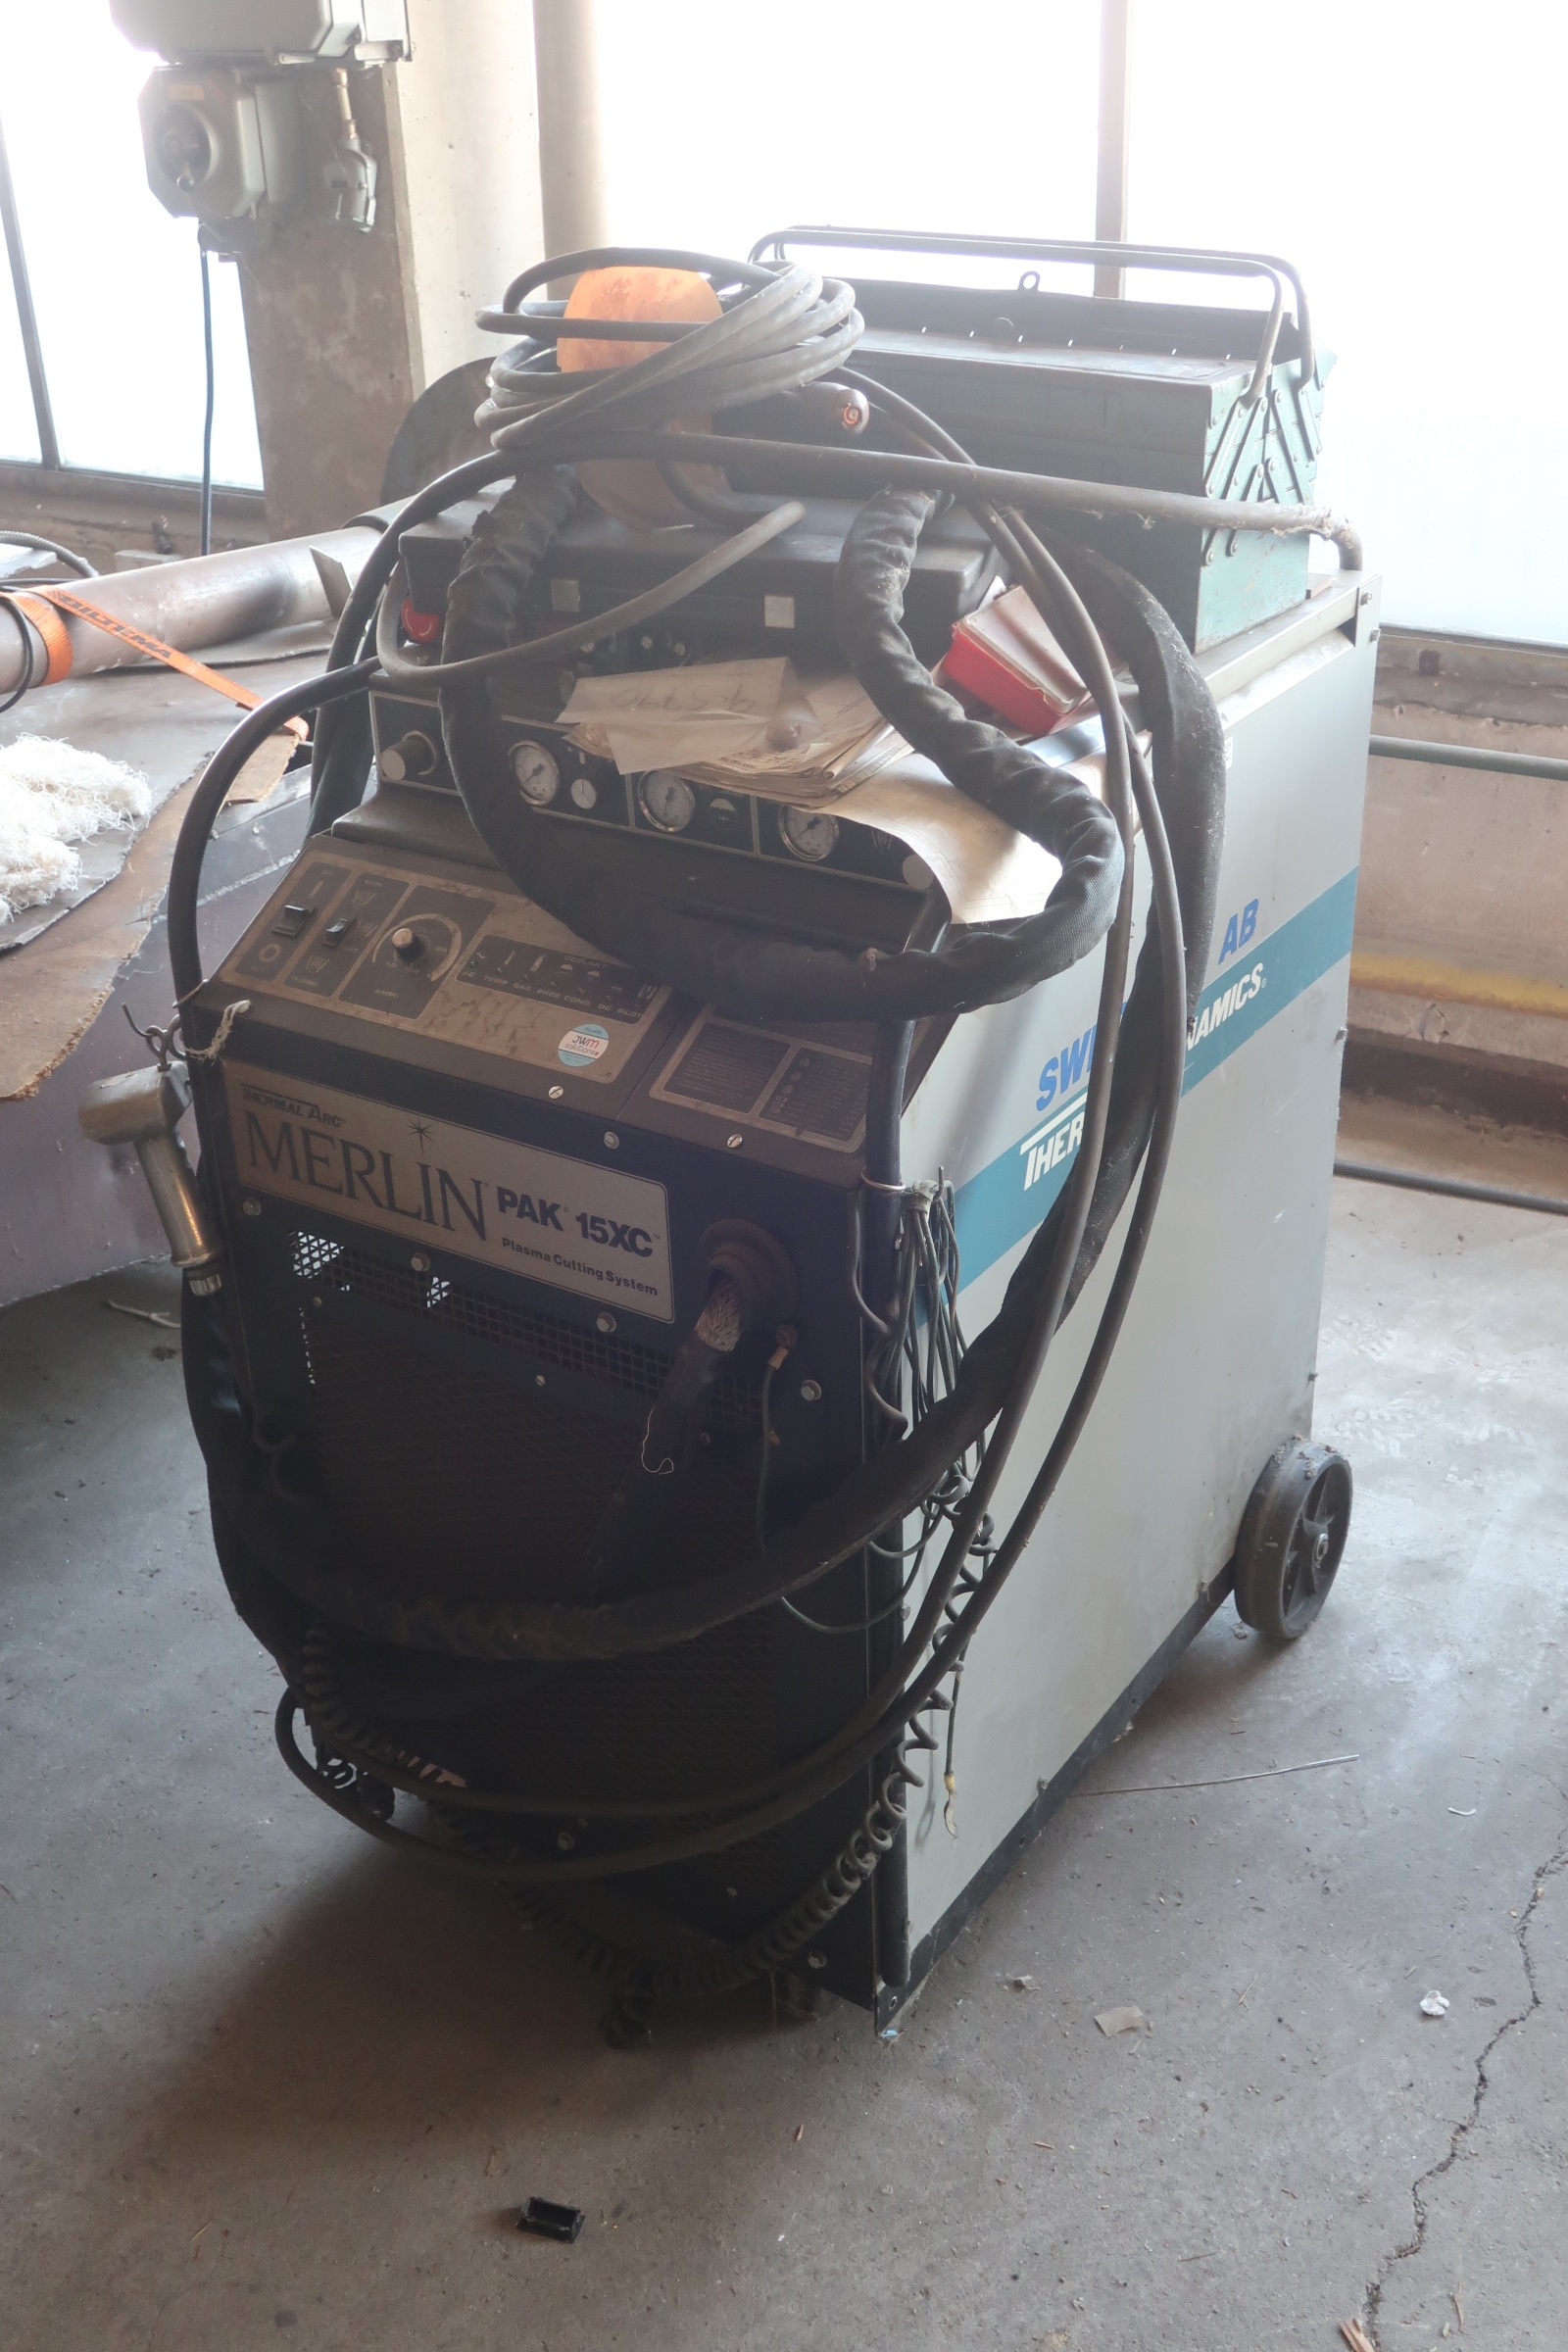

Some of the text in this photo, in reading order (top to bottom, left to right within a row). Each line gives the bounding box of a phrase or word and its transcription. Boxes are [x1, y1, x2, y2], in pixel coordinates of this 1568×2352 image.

[564, 956, 607, 969] COOLANT
[1218, 898, 1259, 965] AB
[484, 975, 508, 985] TEMP
[537, 989, 561, 999] PRES
[564, 996, 590, 1005] COND
[616, 1008, 643, 1018] PILOT
[244, 1109, 487, 1242] MERLIN
[498, 1186, 654, 1258] PAK 15XC
[502, 1238, 659, 1296] Plasma Cutting System
